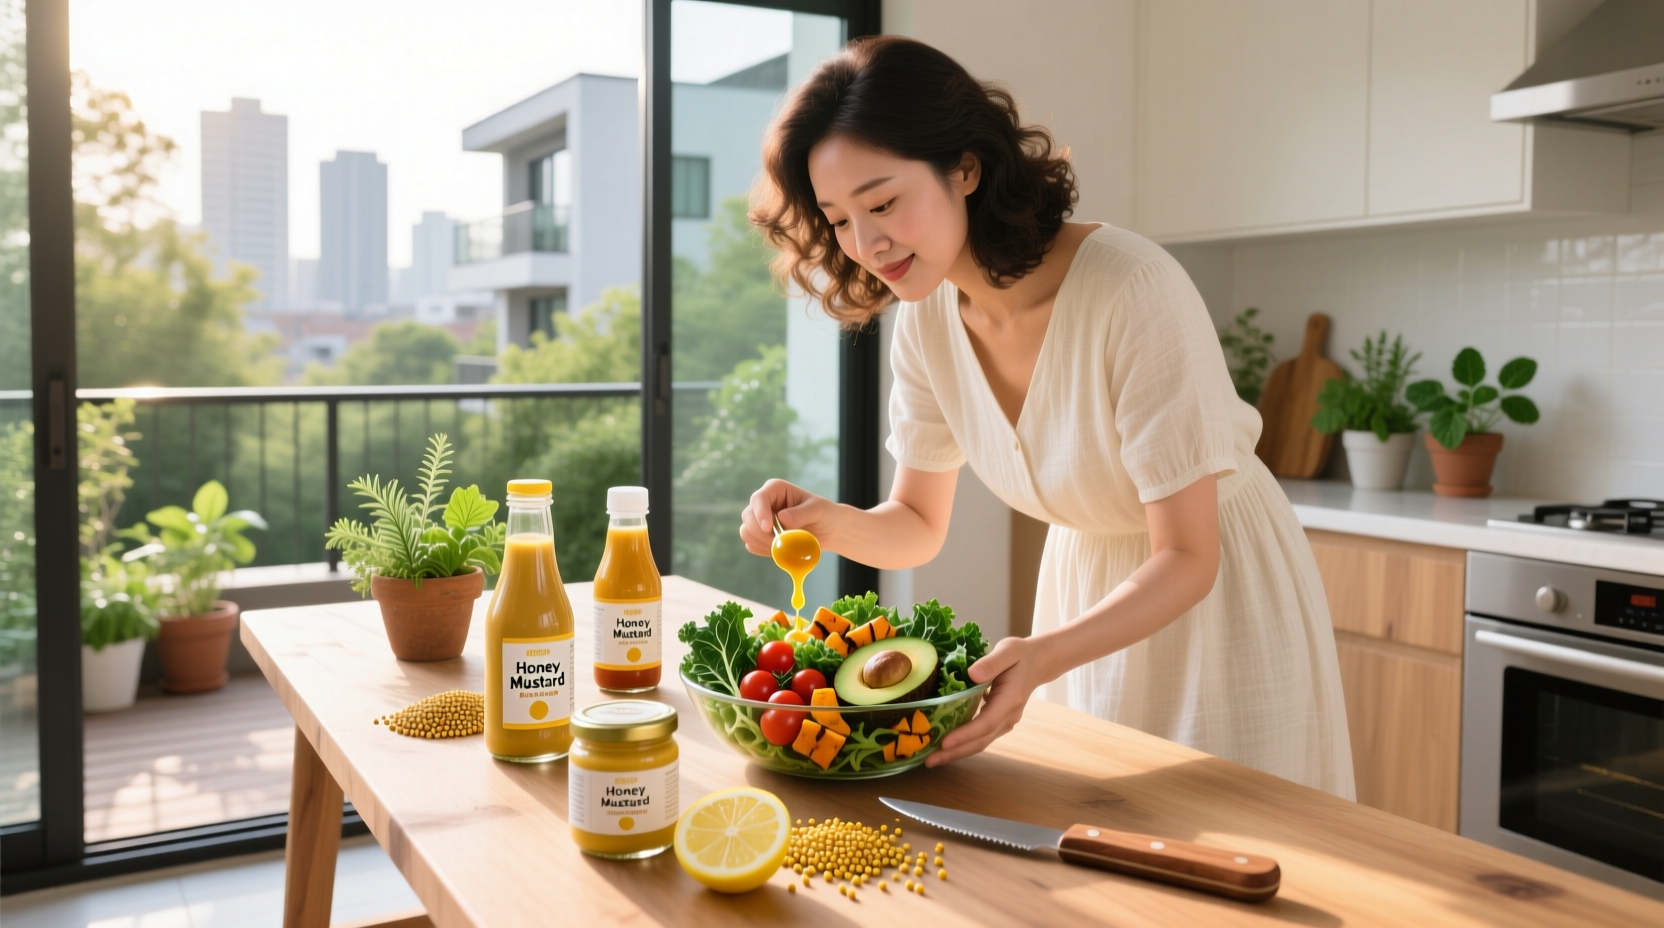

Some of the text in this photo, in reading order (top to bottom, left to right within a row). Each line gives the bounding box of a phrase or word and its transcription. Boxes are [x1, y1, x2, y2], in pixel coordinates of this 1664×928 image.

[616, 618, 651, 629] Honey
[516, 661, 561, 674] Honey
[510, 671, 565, 689] Mustard
[606, 786, 646, 796] Honey
